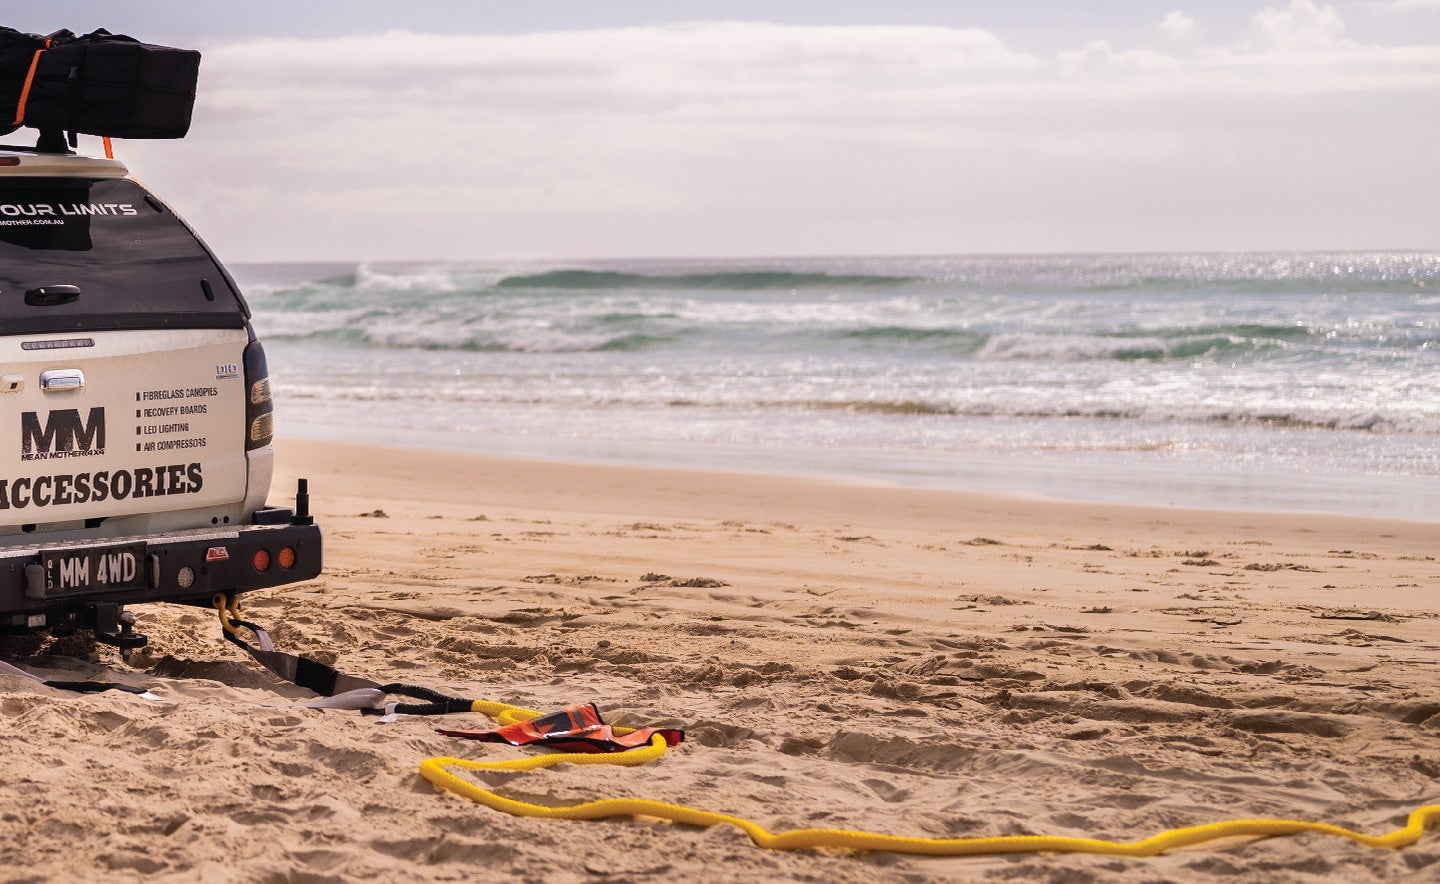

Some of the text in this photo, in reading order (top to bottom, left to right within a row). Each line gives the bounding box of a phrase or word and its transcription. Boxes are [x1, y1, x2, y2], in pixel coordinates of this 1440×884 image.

[58, 203, 138, 216] LIMITS
[143, 387, 218, 401] FIBREGLASS CANOPIES
[144, 405, 208, 417] RECOVERY BOARDS
[21, 407, 106, 453] MM
[144, 423, 189, 435] LED LIGHTING
[143, 438, 207, 452] AIR COMPRESSORS
[21, 452, 48, 461] MEAN
[60, 552, 136, 588] MM 4WD
